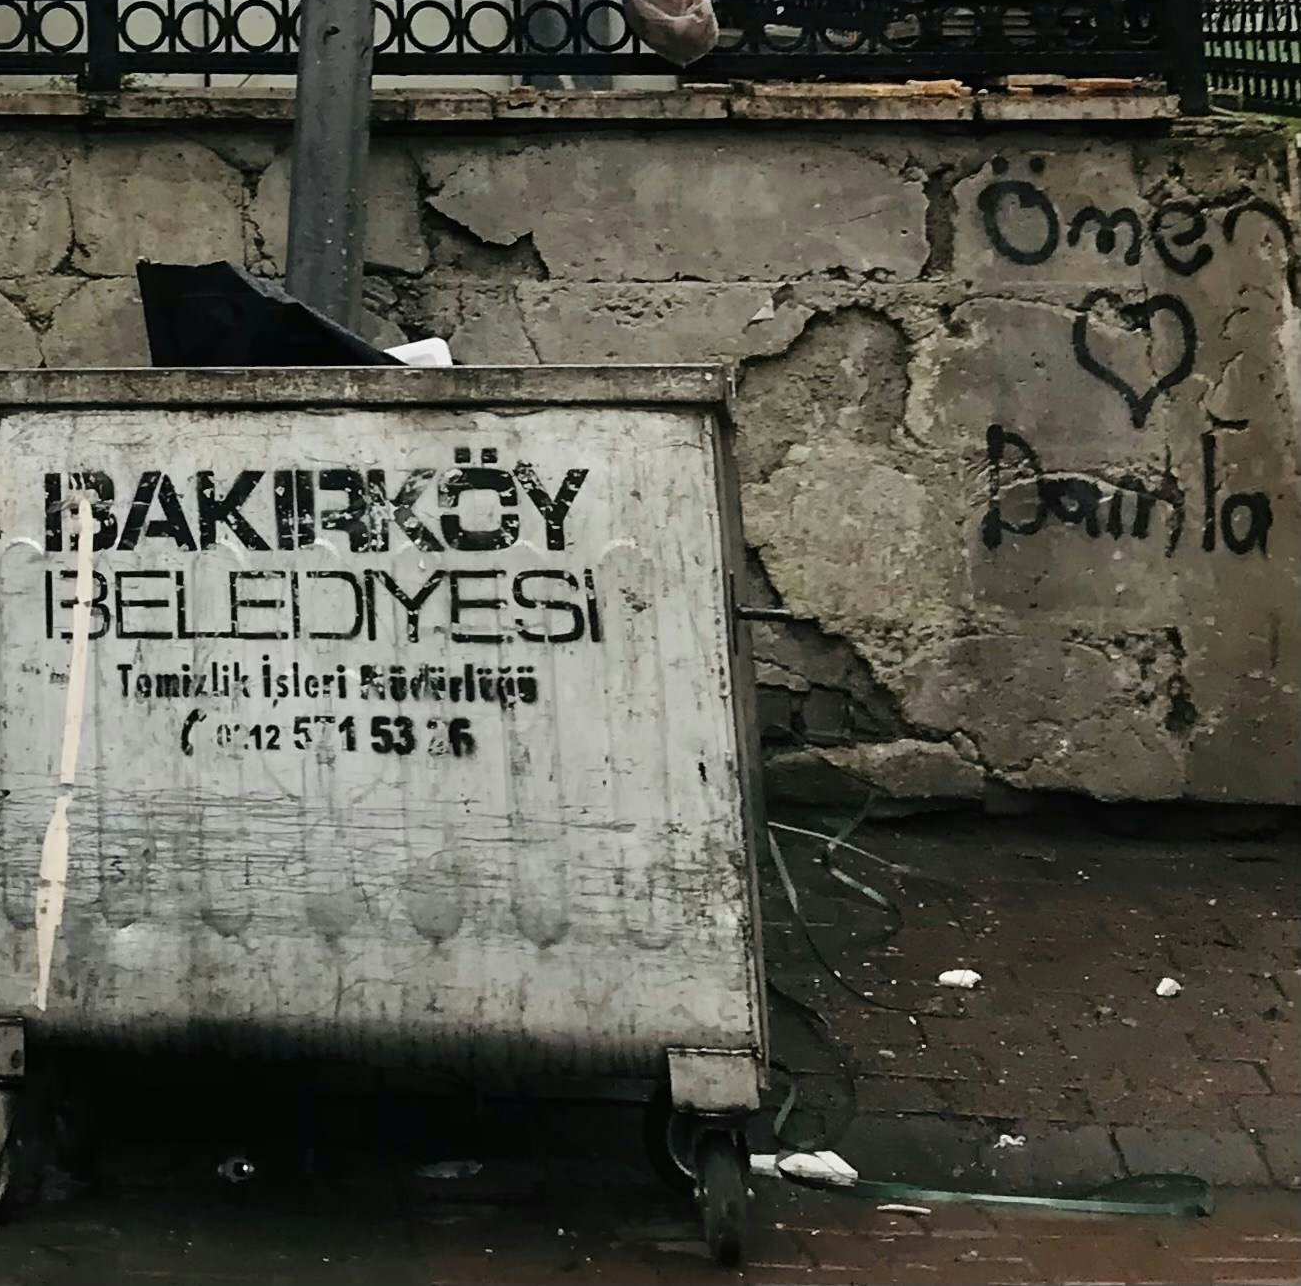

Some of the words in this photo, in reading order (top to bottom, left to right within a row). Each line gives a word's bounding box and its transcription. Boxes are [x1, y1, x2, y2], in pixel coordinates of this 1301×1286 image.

[44, 446, 590, 552] BAKIRKÖY
[117, 663, 250, 700] Temizlik
[261, 654, 348, 708] İşleri
[370, 715, 417, 755] 53
